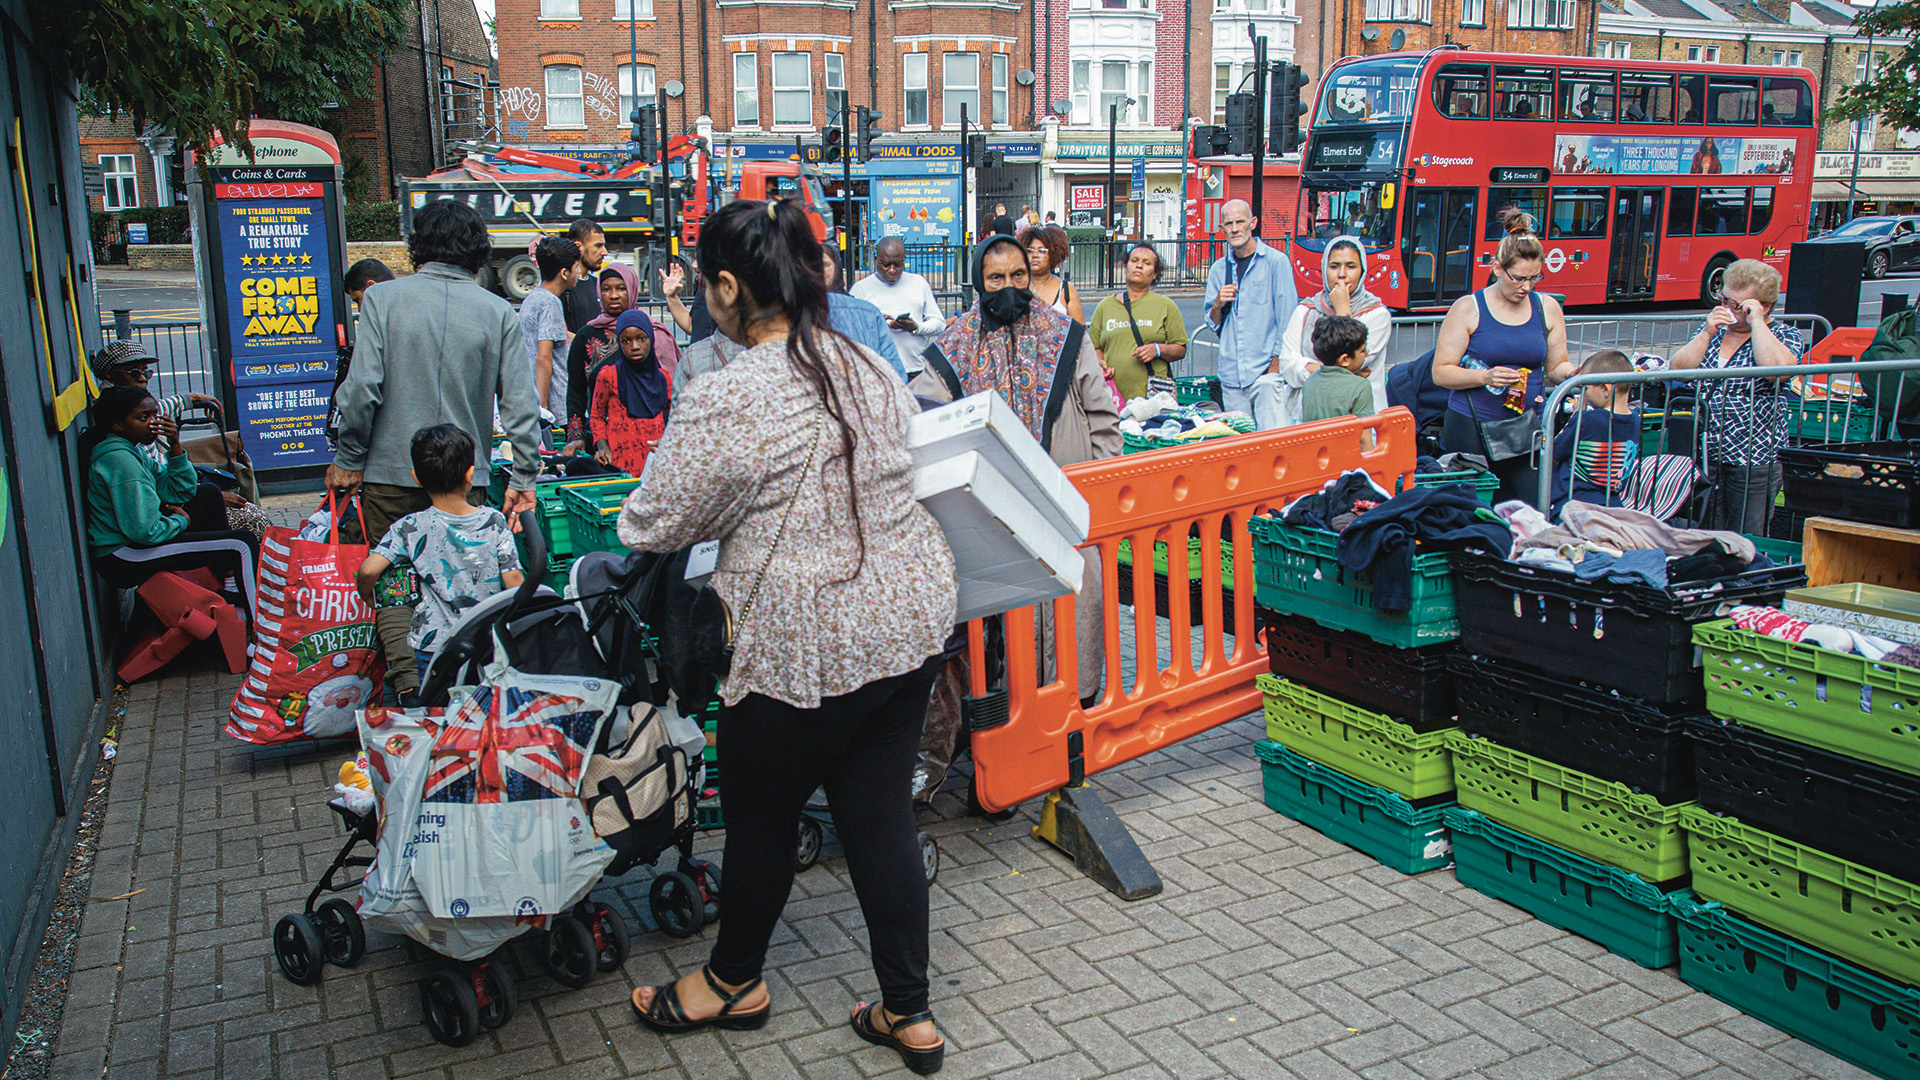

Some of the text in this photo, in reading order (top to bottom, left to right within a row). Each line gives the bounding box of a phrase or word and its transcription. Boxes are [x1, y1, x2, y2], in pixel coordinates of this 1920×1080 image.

[880, 147, 912, 156] NIMAL
[1057, 144, 1108, 156] FURNITURE
[1115, 145, 1144, 156] RKADE
[1323, 141, 1394, 158] Elmers End 54
[1623, 146, 1678, 159] THREE THOUSAND
[1744, 151, 1776, 160] SEPTEMBER
[1432, 156, 1473, 168] Stagecoach
[1620, 160, 1678, 172] YEARS OF LONGING
[1820, 156, 1882, 168] BLACK-EATH
[232, 168, 307, 180] Coins & Cards
[1502, 171, 1512, 180] 54
[1076, 188, 1100, 199] SALE
[437, 194, 620, 216] IVYER
[240, 224, 310, 236] A REMARKABLE
[248, 236, 302, 249] TRUE STORY
[240, 276, 317, 296] COME
[242, 295, 318, 316] FROM
[243, 314, 318, 336] AWAY
[274, 392, 284, 400] OF
[285, 390, 298, 400] THE
[299, 389, 316, 398] BEST
[248, 402, 273, 411] SHOWS
[274, 400, 284, 408] OF
[285, 399, 298, 408] THE
[260, 428, 324, 440] PHOENIX THEATRE
[302, 562, 336, 574] FRAGILE
[310, 624, 378, 655] PRESEN
[418, 811, 446, 828] ning
